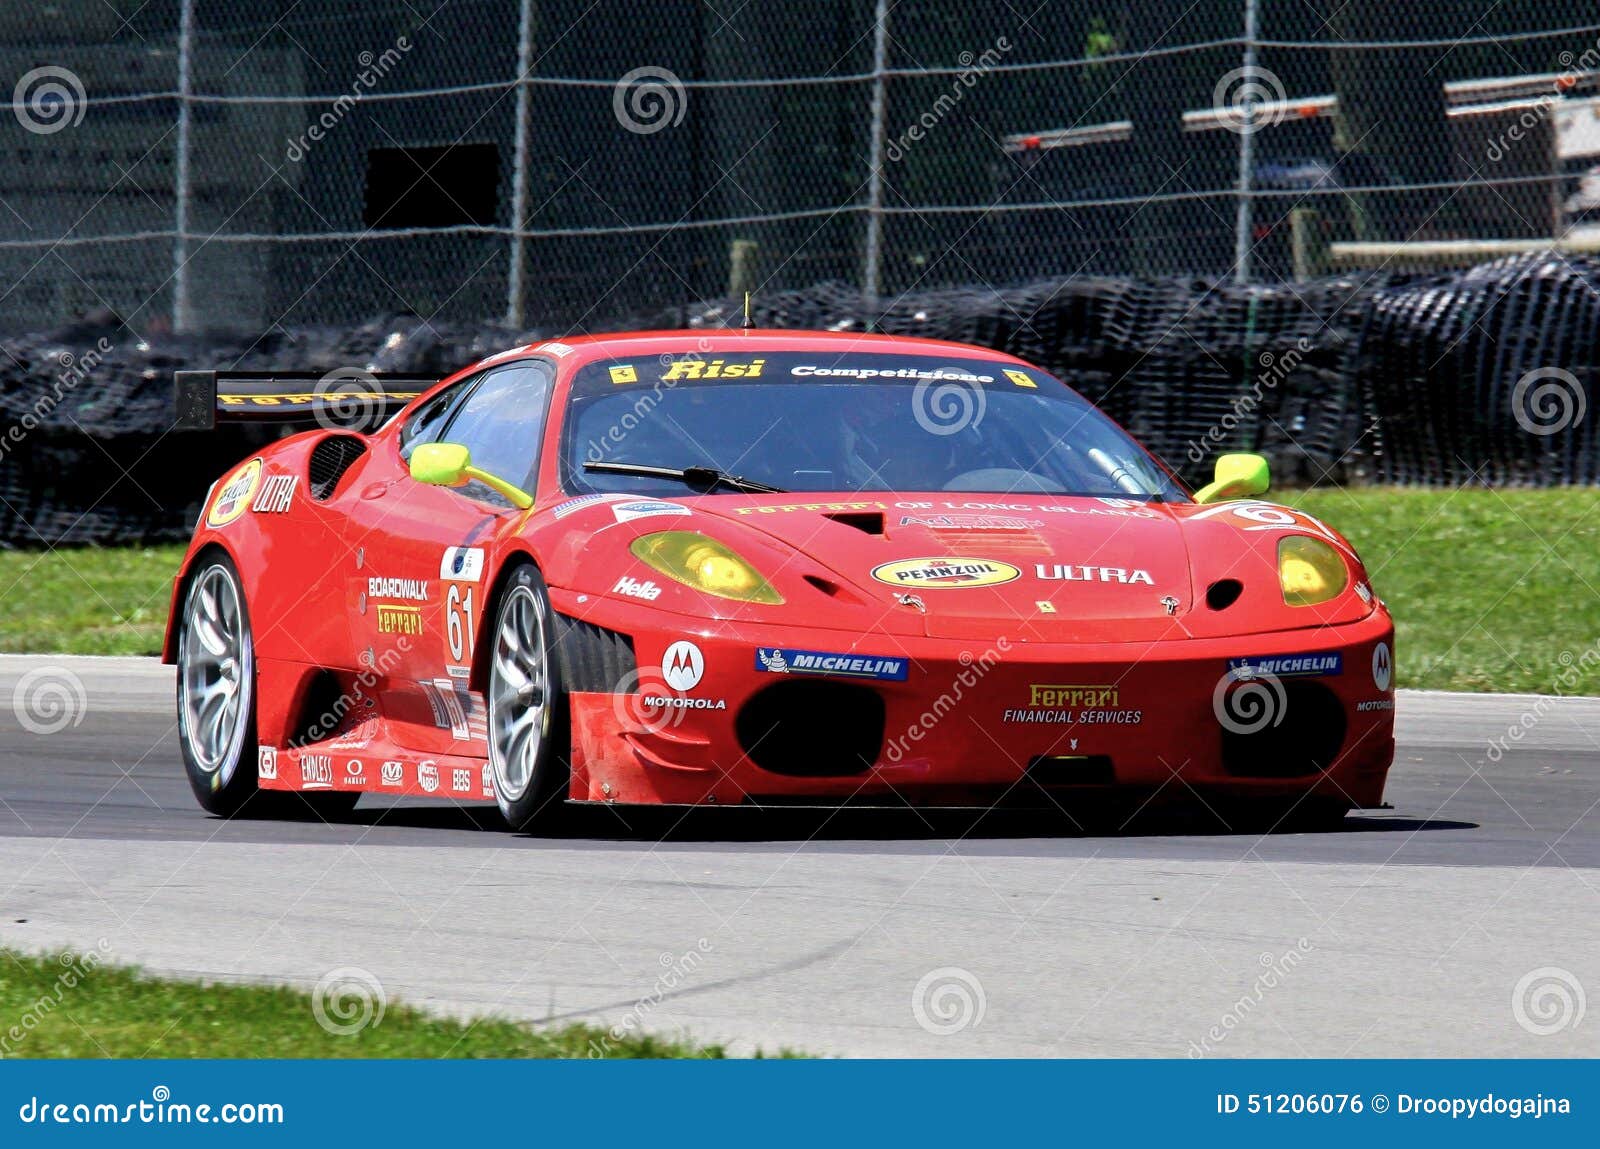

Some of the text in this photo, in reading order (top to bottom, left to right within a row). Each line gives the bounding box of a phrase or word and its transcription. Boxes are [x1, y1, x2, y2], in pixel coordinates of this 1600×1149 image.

[662, 359, 994, 384] Risi Competizione
[252, 475, 299, 512] ULTRA
[942, 502, 1032, 511] LONG
[896, 564, 998, 581] PENNZOIL
[1035, 564, 1155, 585] ULTRA
[368, 577, 428, 600] BOARDWALK
[612, 576, 661, 600] Hella
[377, 604, 423, 635] Ferrari
[446, 584, 476, 661] 61
[792, 654, 900, 675] MICHELIN
[1257, 656, 1338, 673] MICHELIN
[644, 696, 726, 710] MOTOROLA
[1029, 684, 1119, 707] Ferrari
[1003, 709, 1142, 724] FINANCIAL SERVICES
[452, 768, 470, 791] BBS
